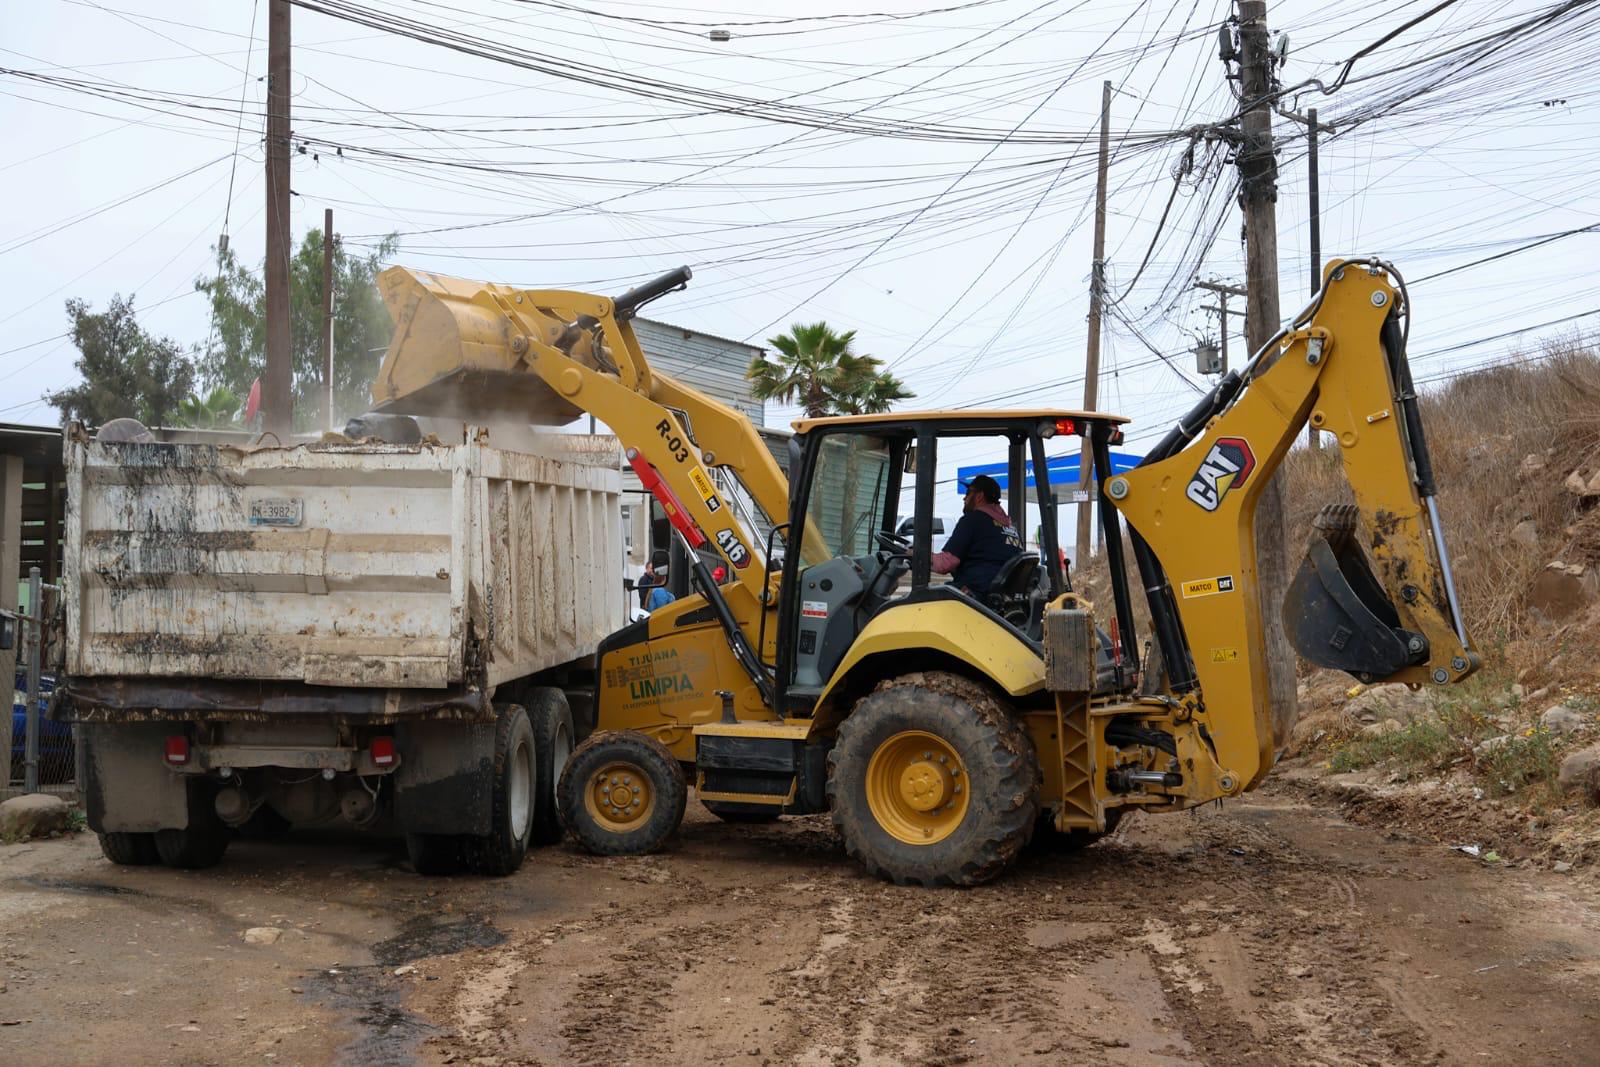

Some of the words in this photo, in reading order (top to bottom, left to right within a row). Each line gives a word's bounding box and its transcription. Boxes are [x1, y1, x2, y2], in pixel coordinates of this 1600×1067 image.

[656, 419, 689, 463] R-03
[694, 474, 709, 494] MATCO
[1187, 444, 1241, 511] CAT
[716, 529, 747, 562] 416
[1190, 583, 1212, 592] MATCO
[629, 648, 679, 666] TIJUANA
[630, 673, 694, 700] LIMPIA
